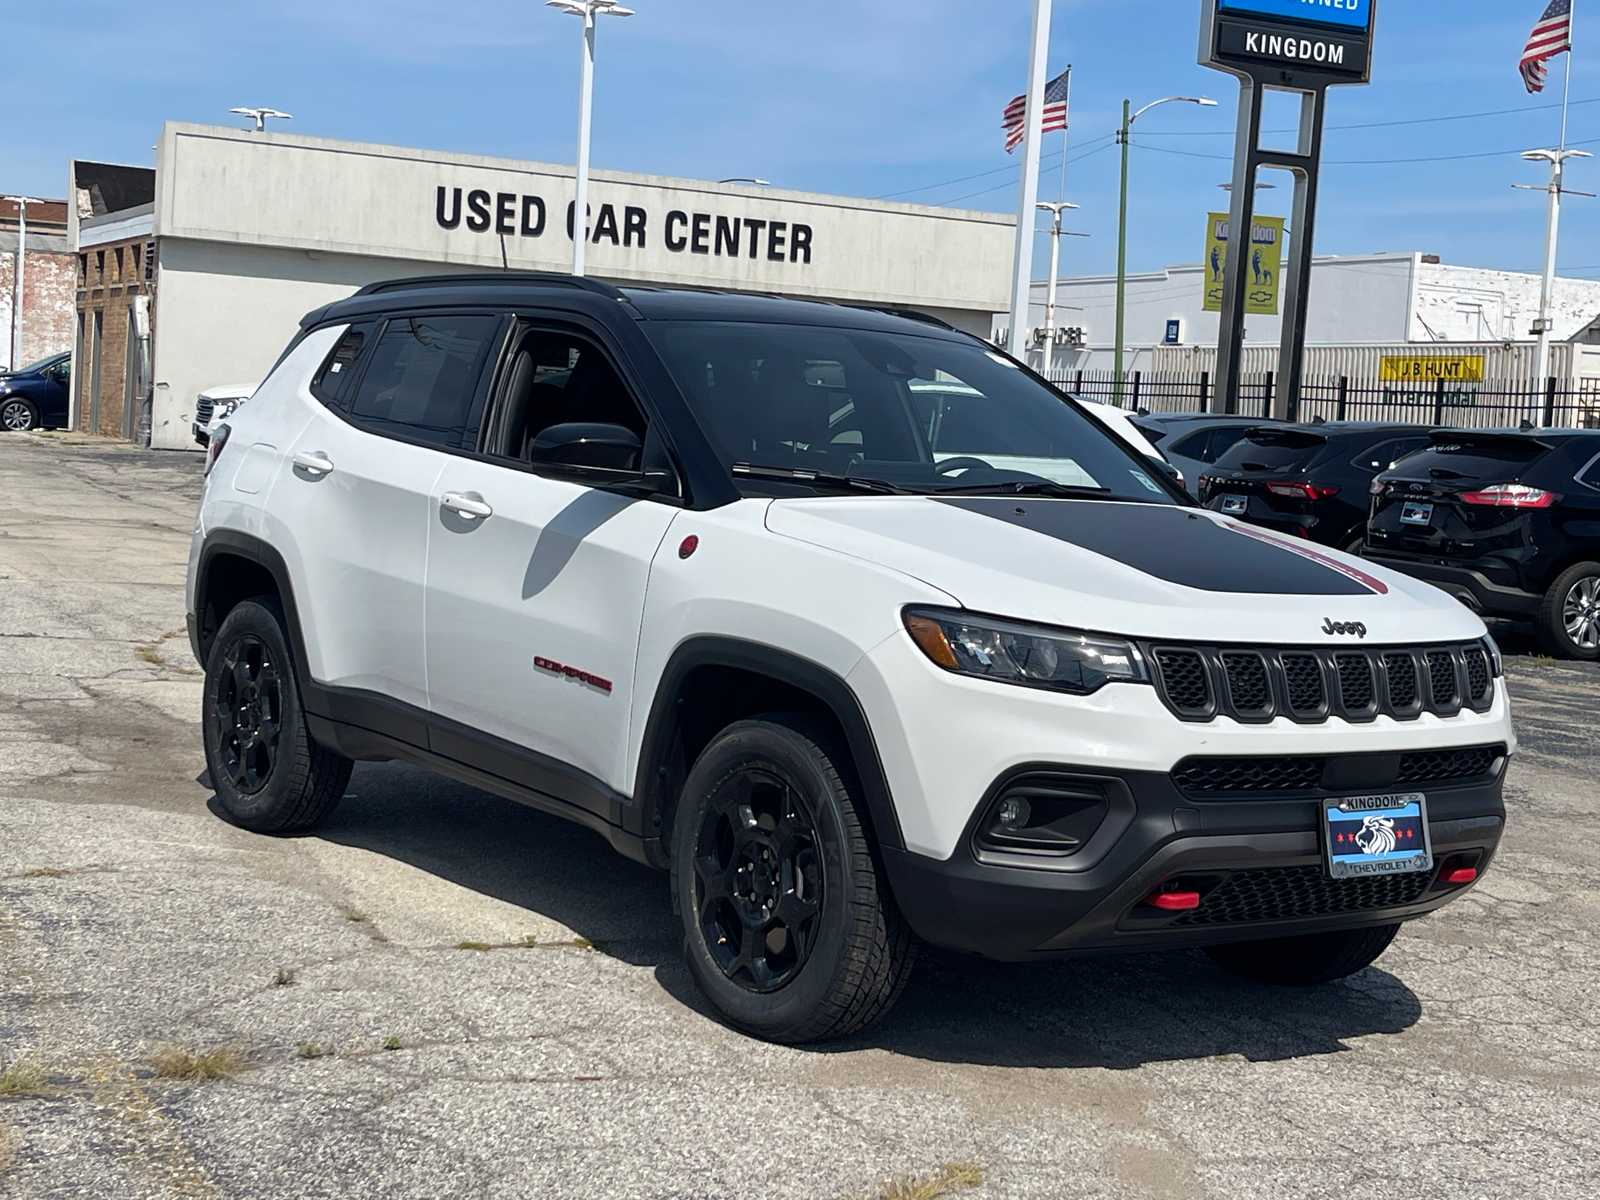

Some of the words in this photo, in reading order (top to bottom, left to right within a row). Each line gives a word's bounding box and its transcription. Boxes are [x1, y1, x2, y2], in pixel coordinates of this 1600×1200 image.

[1245, 32, 1344, 64] KINGDOM
[436, 185, 546, 238] USED
[566, 199, 647, 248] CAR
[664, 209, 813, 264] CENTER
[1425, 362, 1460, 377] HUNT
[1321, 617, 1367, 639] Jeep
[1347, 795, 1401, 809] KINGDOM
